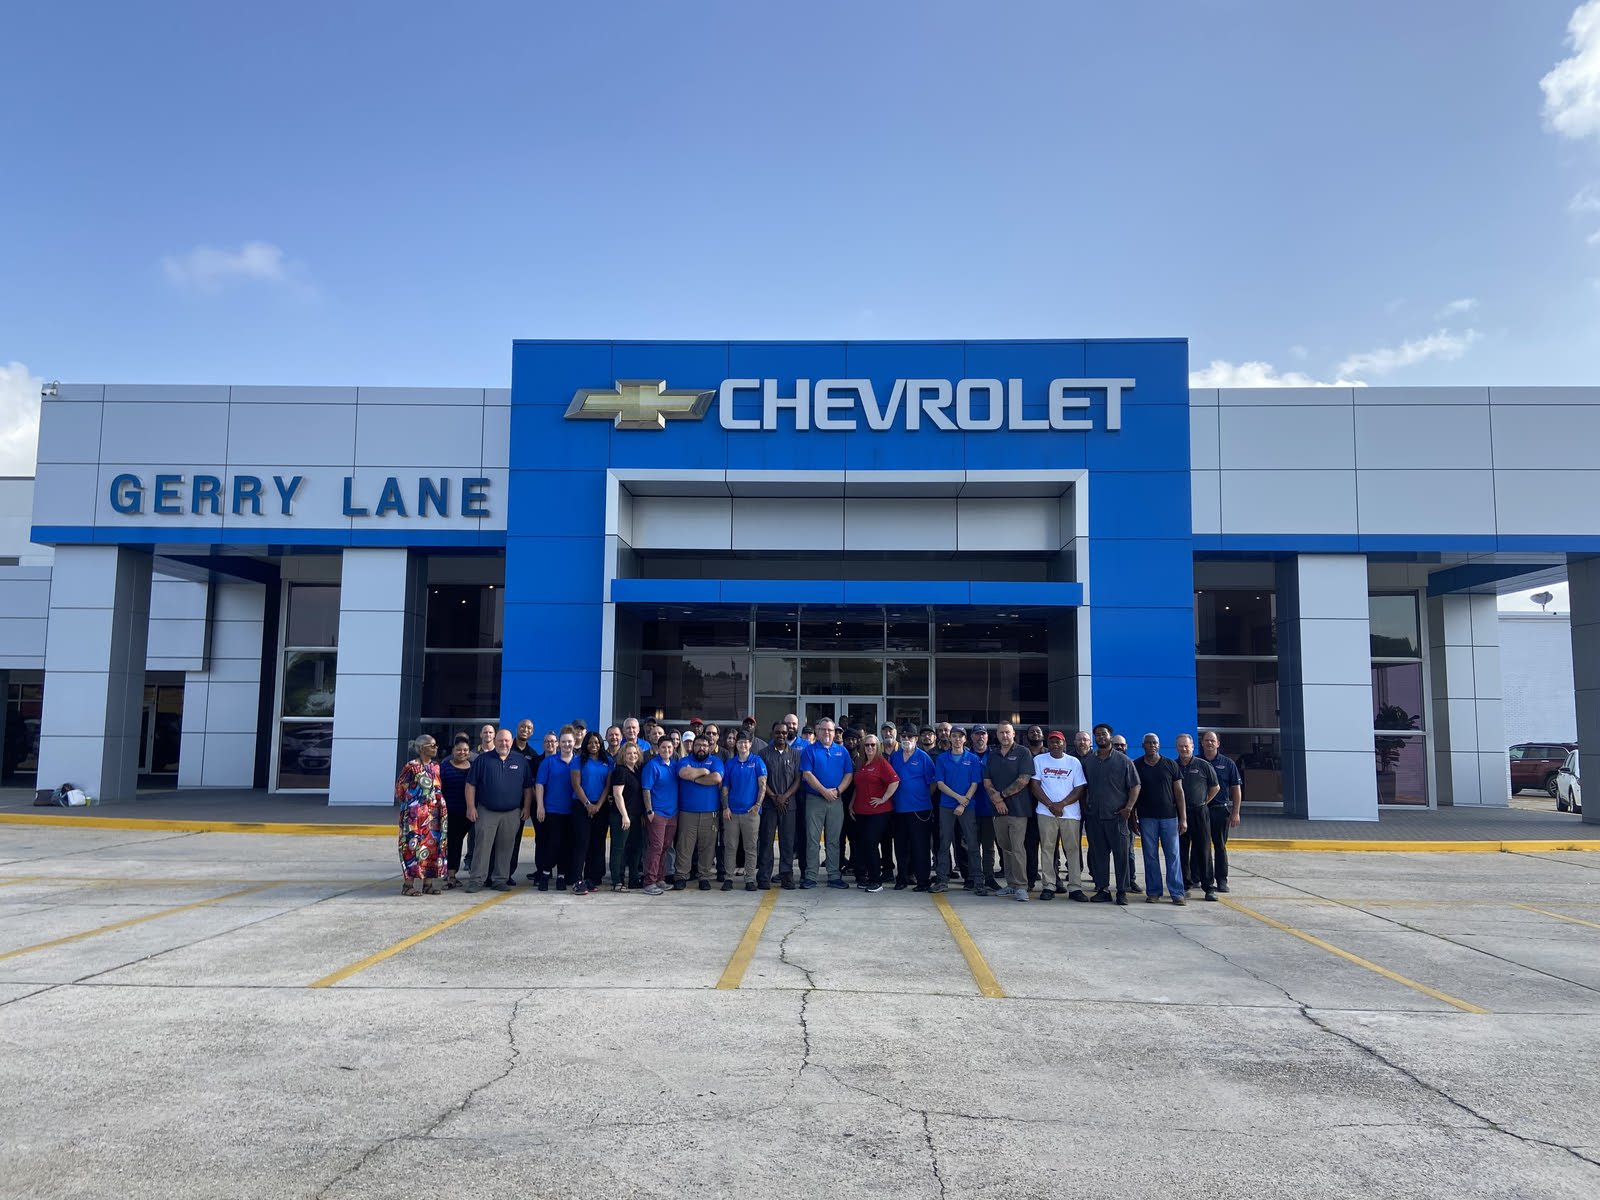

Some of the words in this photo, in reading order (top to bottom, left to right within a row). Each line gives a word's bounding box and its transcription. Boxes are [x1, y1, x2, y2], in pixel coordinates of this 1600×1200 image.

[719, 377, 1137, 431] CHEVROLET
[110, 473, 303, 516] GERRY
[342, 476, 492, 518] LANE
